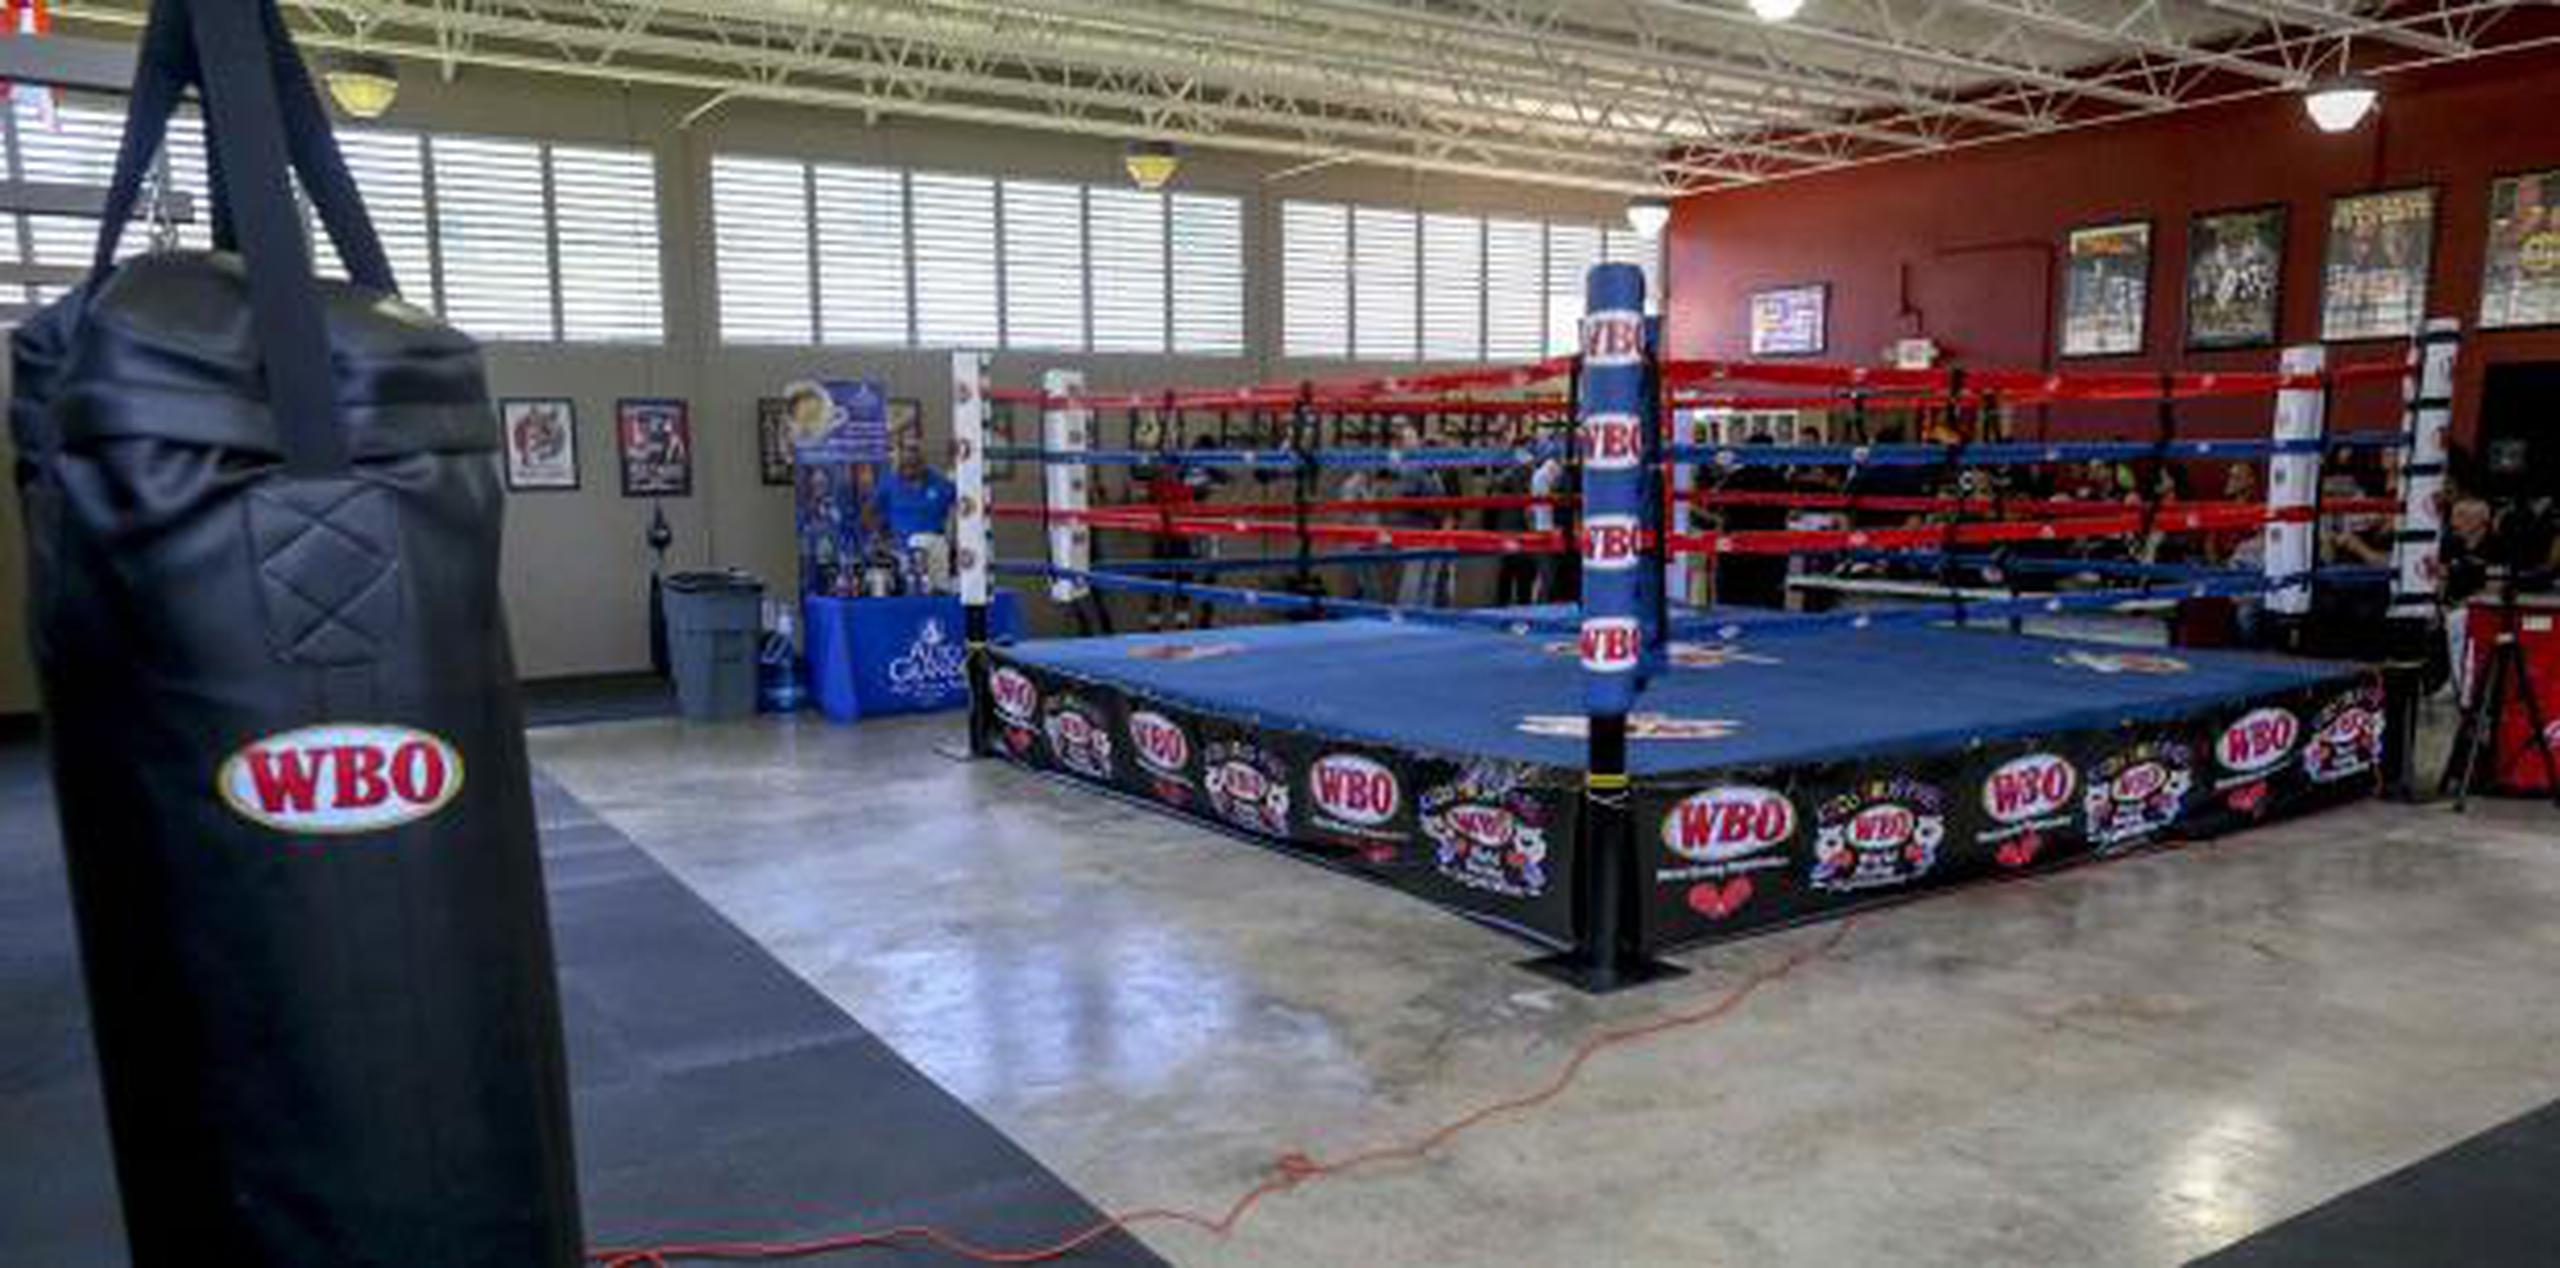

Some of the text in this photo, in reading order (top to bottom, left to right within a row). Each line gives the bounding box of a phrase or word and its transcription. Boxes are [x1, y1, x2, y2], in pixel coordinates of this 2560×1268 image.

[1131, 716, 1184, 764] WBO
[2228, 714, 2292, 763] WBO
[243, 739, 446, 813] WBO
[1318, 764, 1393, 815] WBO
[1991, 763, 2069, 814] WBO
[1679, 799, 1788, 849] WBO
[1854, 810, 1911, 840] WBO
